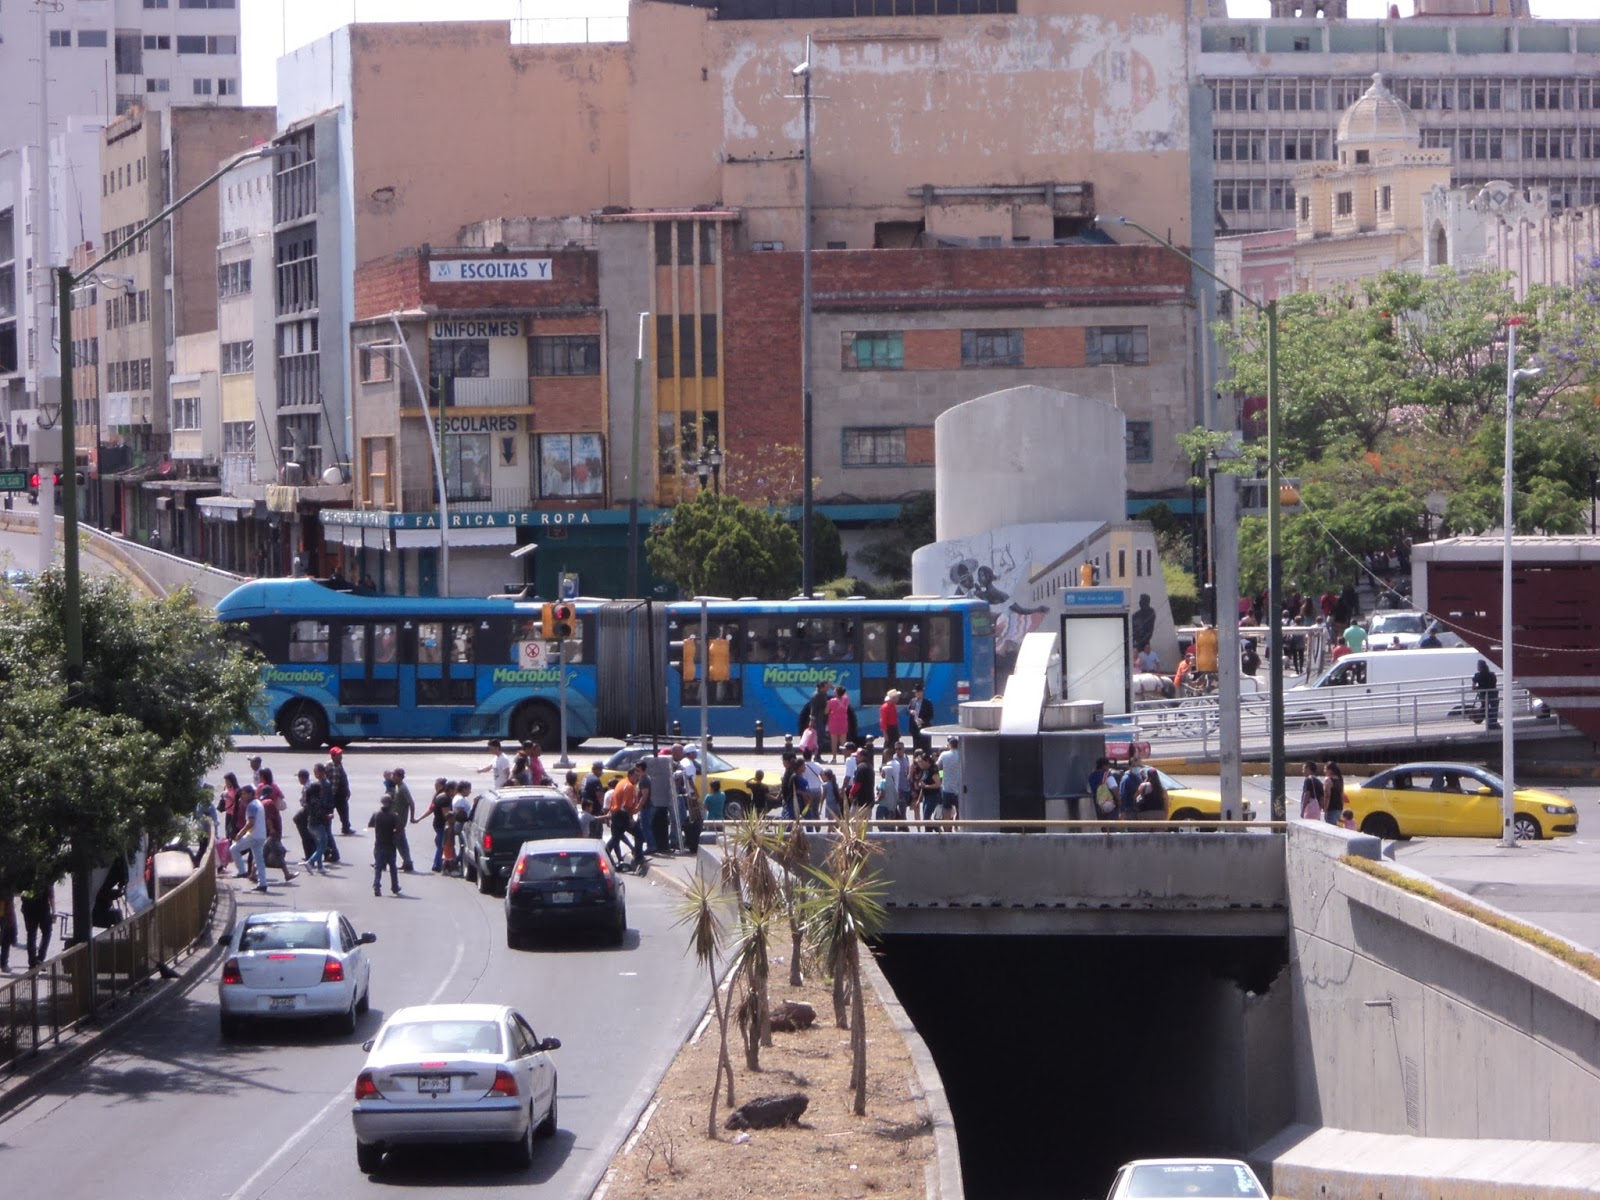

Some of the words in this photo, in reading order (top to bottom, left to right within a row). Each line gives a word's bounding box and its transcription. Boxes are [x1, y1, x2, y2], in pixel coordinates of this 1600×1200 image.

[460, 262, 528, 279] ESCOLTAS
[538, 262, 548, 278] Y
[434, 320, 519, 338] UNIFORMES
[416, 514, 496, 527] FARICA
[508, 513, 528, 525] DE
[541, 512, 590, 524] ROPA
